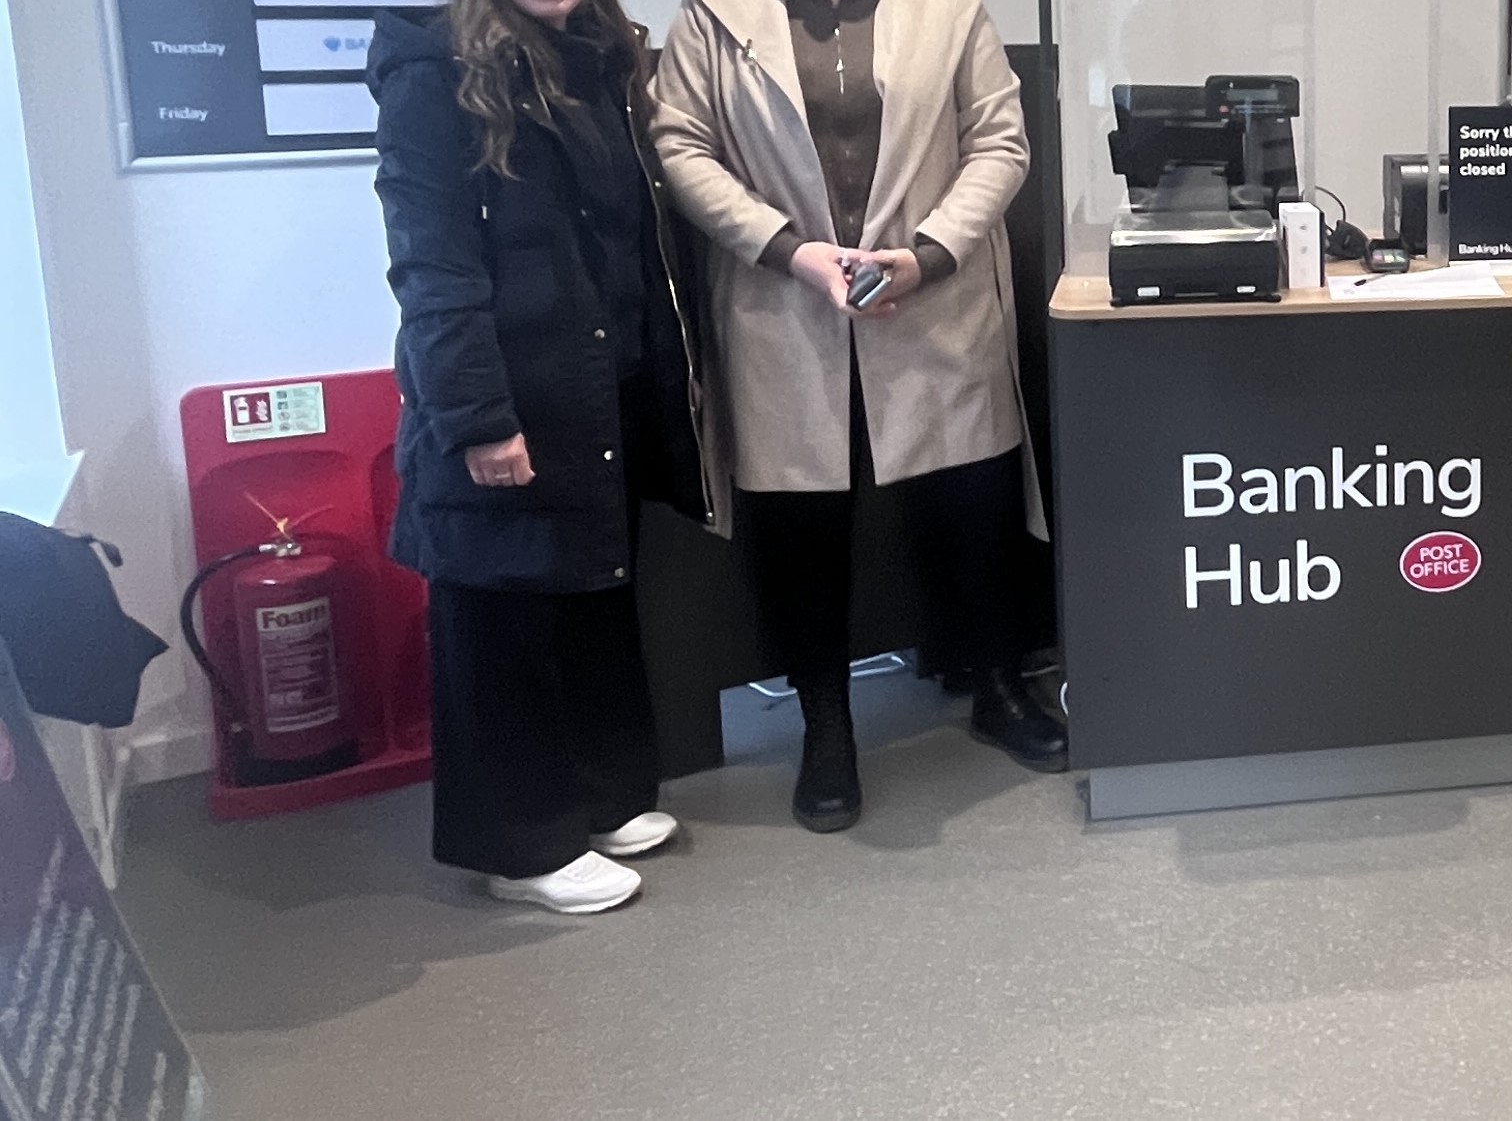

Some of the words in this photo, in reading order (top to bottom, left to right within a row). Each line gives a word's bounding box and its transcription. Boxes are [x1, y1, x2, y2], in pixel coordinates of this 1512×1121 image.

[151, 40, 226, 57] Thursday
[159, 106, 209, 123] Friday
[1459, 125, 1500, 141] Sorry
[1459, 162, 1506, 176] closed
[1458, 243, 1499, 256] Banking
[1182, 444, 1482, 518] Banking
[1419, 543, 1463, 562] POST
[1184, 539, 1341, 609] Hub
[1409, 558, 1470, 579] OFFICE
[262, 604, 328, 629] Foam
